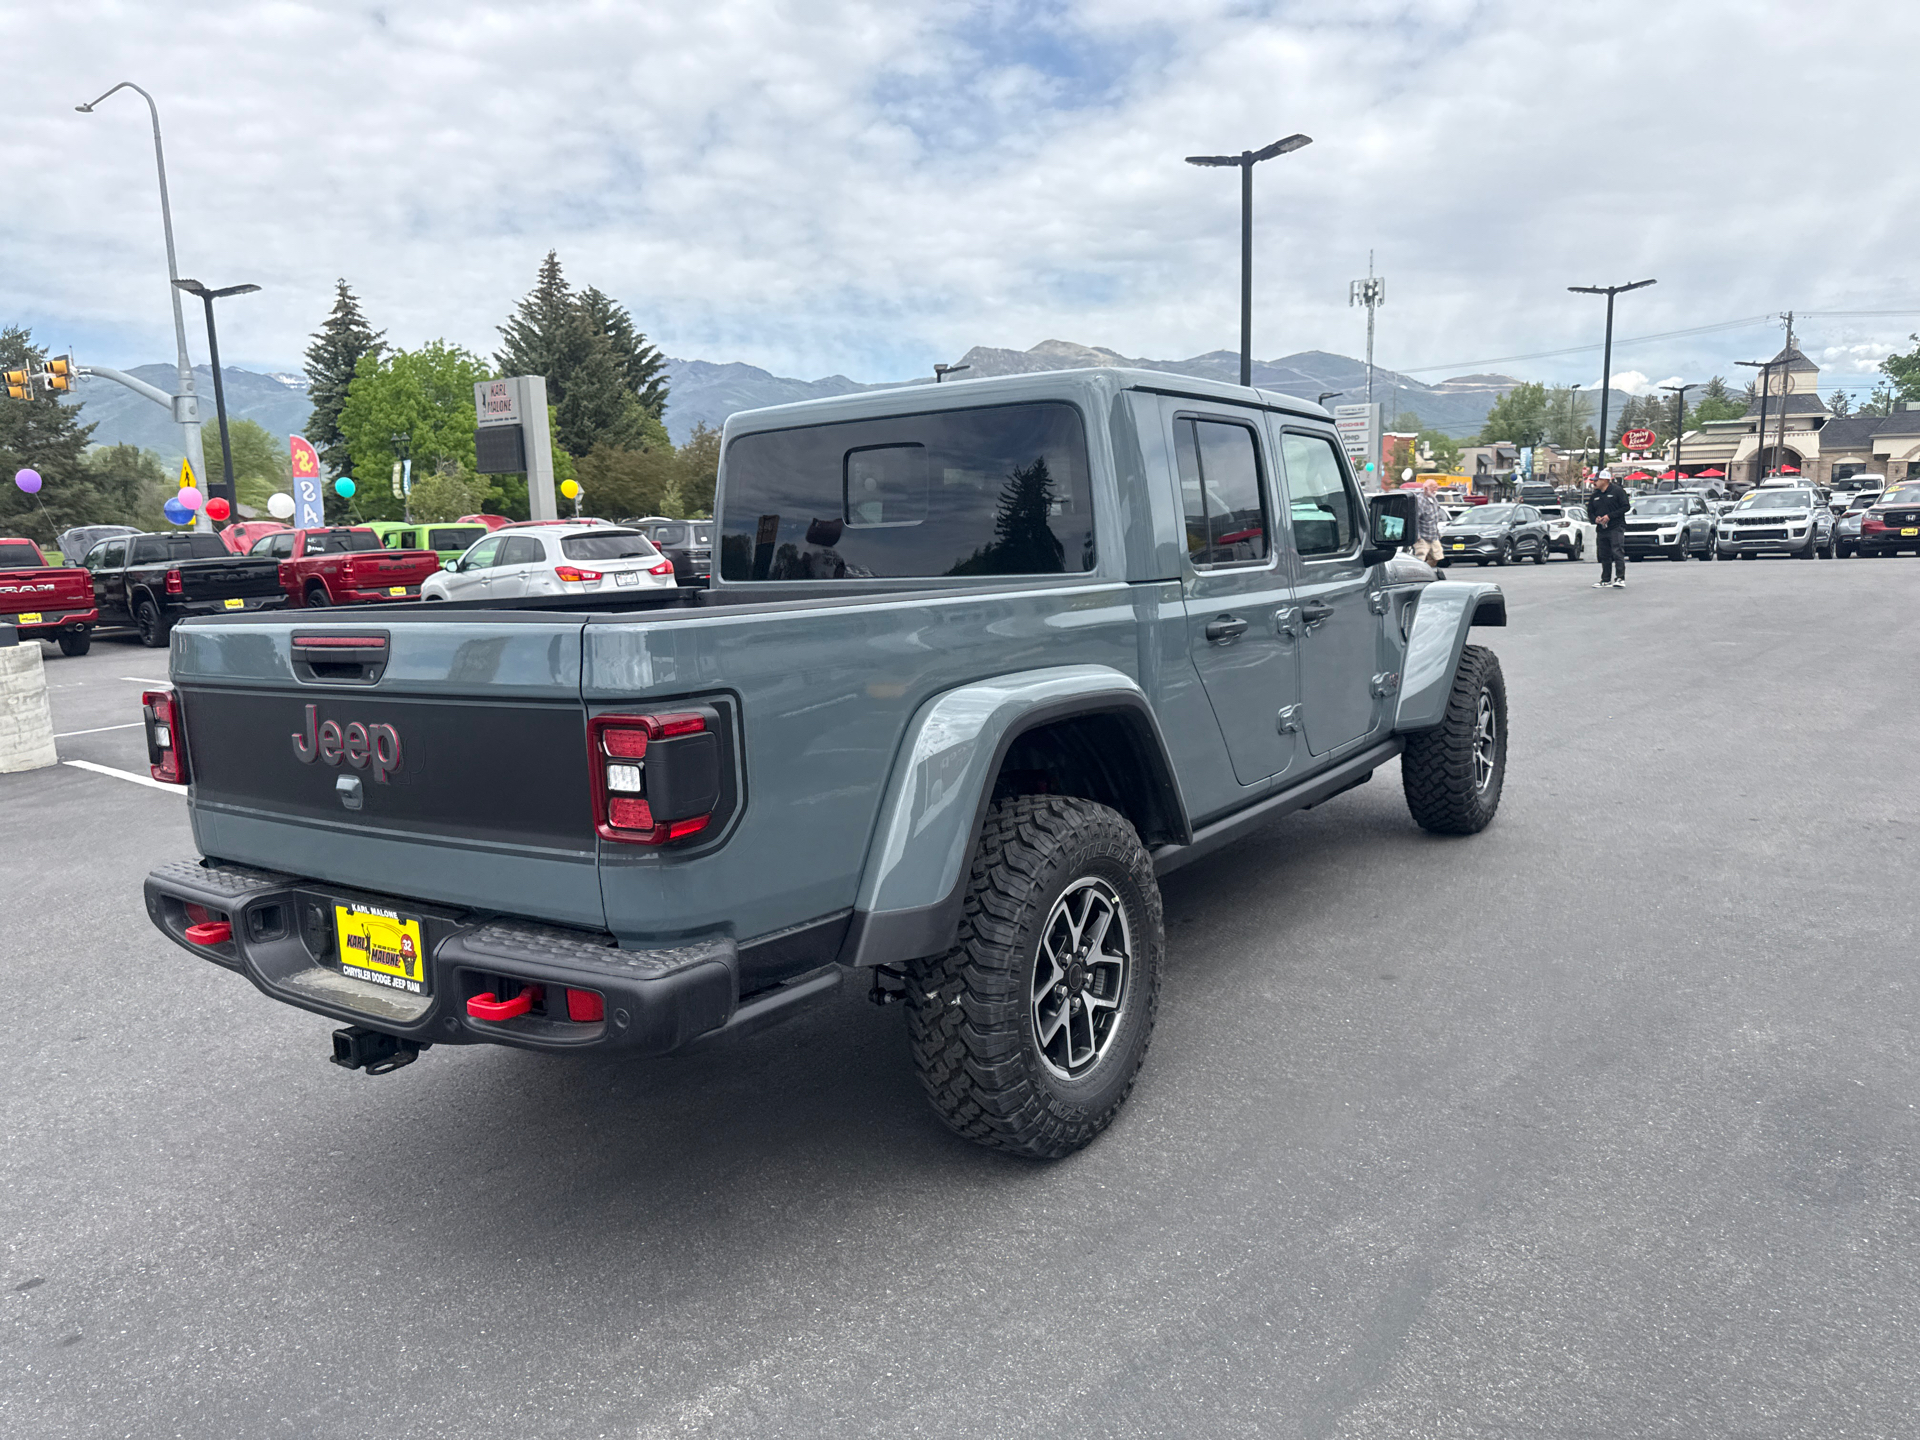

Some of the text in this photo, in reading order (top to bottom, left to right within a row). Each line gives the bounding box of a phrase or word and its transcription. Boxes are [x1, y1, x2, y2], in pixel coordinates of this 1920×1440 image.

[491, 383, 506, 398] KARL
[487, 399, 512, 415] MALONE
[1628, 431, 1649, 441] Dairy
[378, 563, 416, 571] RAM
[0, 584, 55, 594] RAM
[291, 704, 401, 784] Jeep
[351, 903, 399, 919] KARL MALONE
[346, 933, 366, 951] KARL
[370, 948, 401, 968] MALONE
[402, 939, 412, 952] 32
[343, 965, 420, 993] CHRYSLER DODGE JEEP RAM
